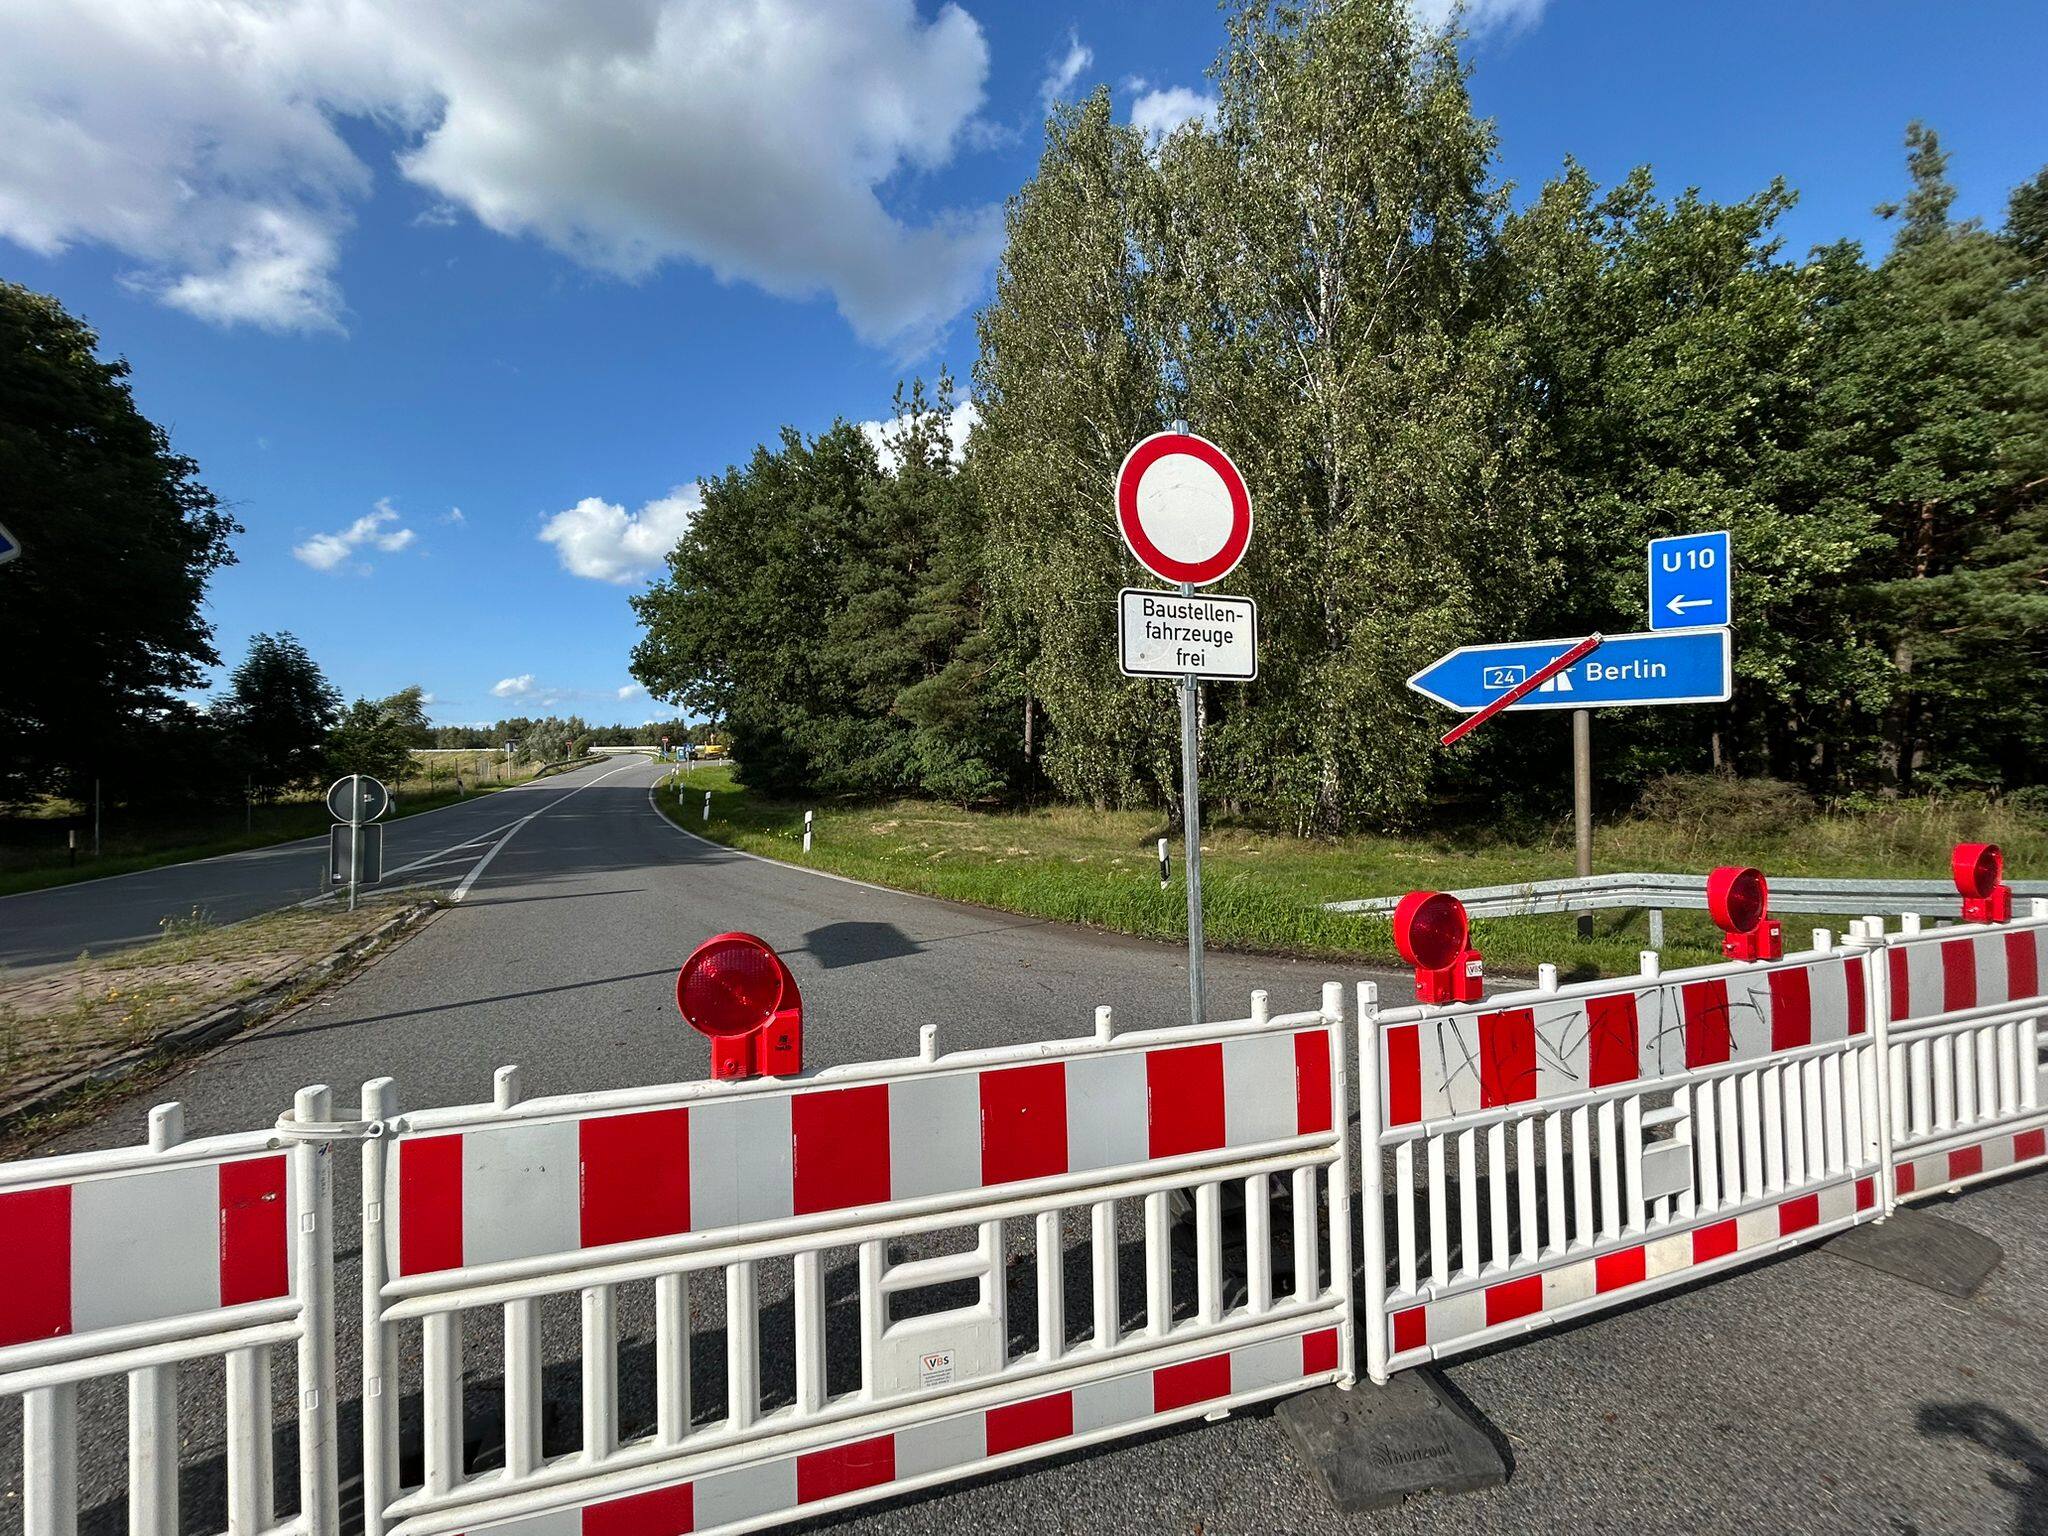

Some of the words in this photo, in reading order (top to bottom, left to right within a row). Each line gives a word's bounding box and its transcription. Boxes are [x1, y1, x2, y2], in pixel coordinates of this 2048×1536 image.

[1143, 598, 1244, 622] Baustellen-
[1145, 621, 1234, 648] fahrzeuge
[1176, 647, 1206, 667] frei
[1493, 670, 1516, 686] 24
[1586, 659, 1667, 682] Berlin
